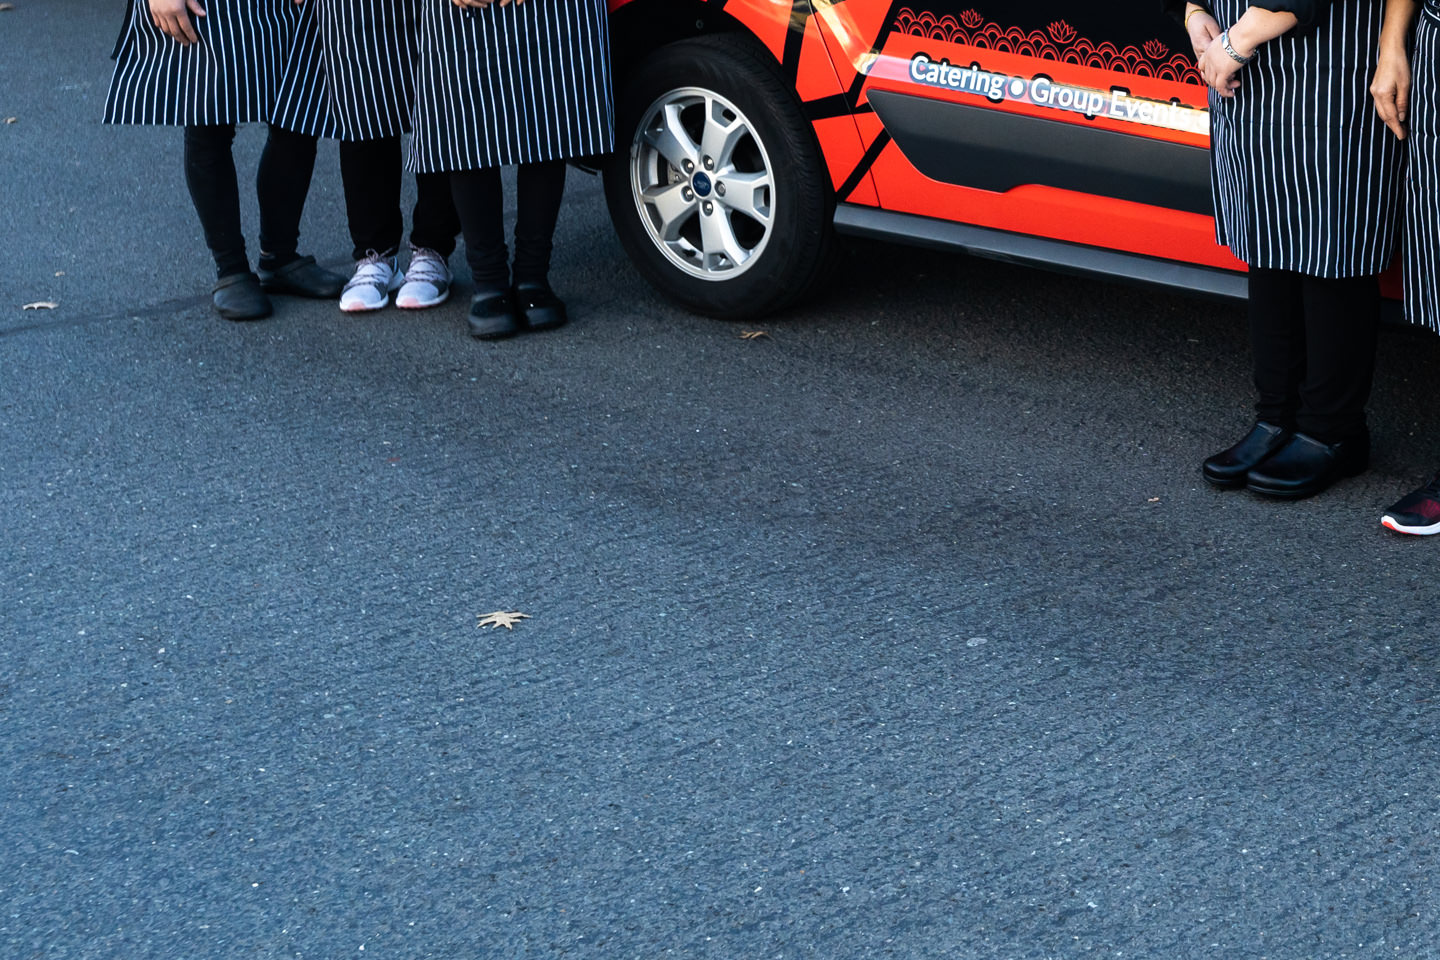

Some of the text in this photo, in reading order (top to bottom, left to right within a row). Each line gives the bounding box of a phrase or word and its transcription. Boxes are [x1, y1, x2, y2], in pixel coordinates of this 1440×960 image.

[910, 55, 1192, 126] Catering Group Events
